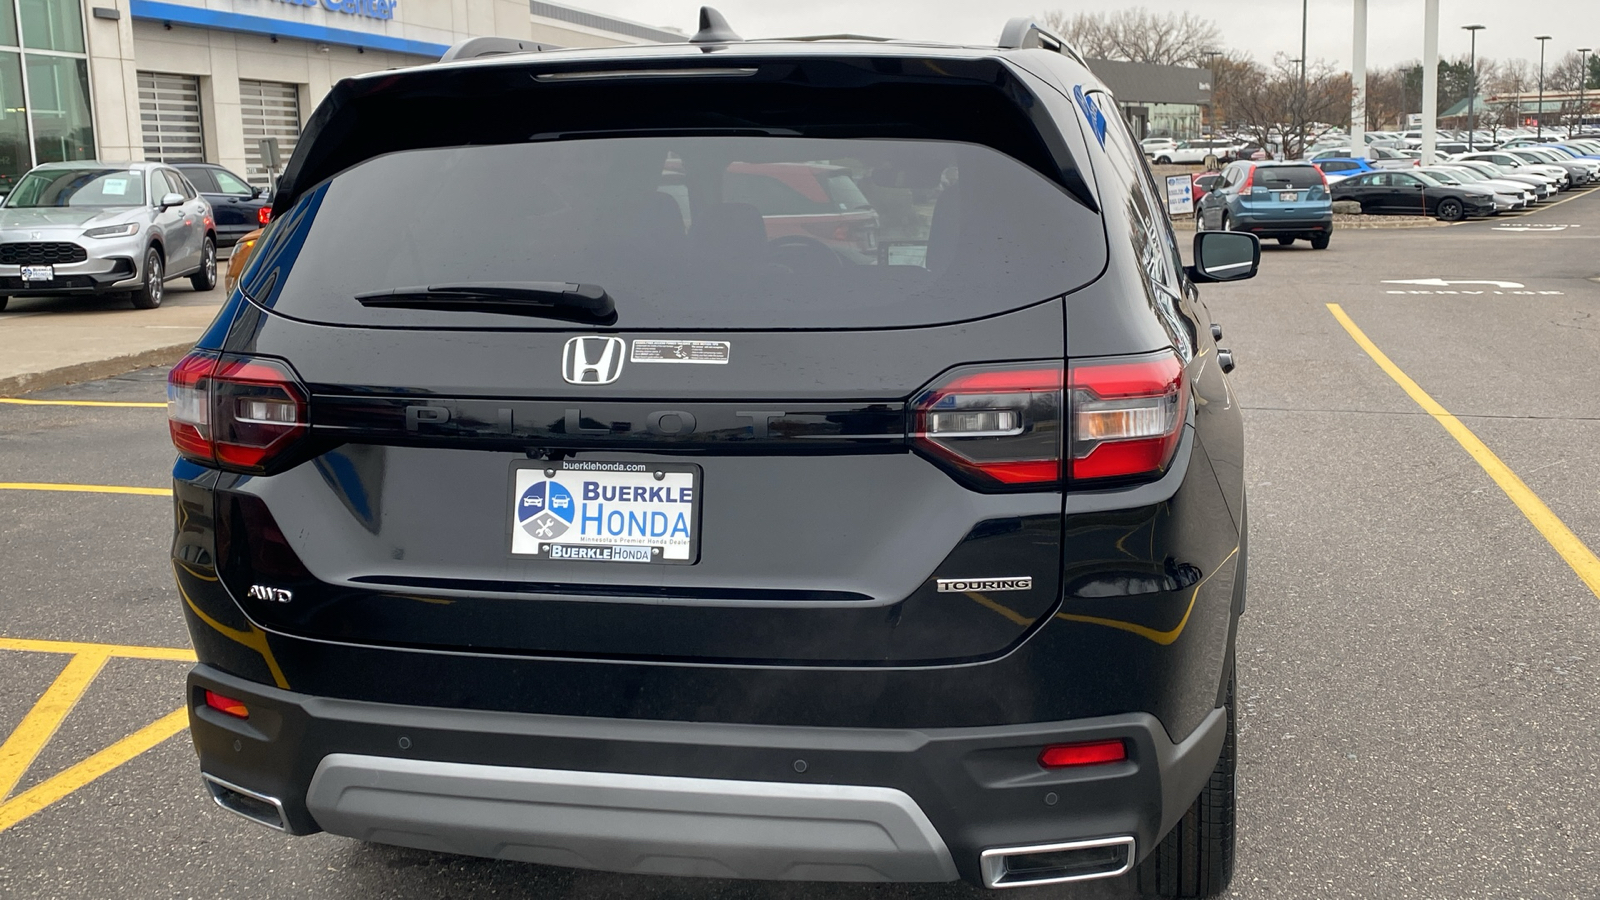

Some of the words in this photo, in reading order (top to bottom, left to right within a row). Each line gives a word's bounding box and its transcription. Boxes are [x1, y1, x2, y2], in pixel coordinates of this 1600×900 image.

[405, 405, 786, 438] PILOT
[562, 461, 646, 472] buerklehonda.com
[582, 481, 692, 503] BUERKLE
[580, 503, 690, 538] HONDA
[247, 585, 292, 603] AWD
[940, 580, 1029, 590] TOURING
